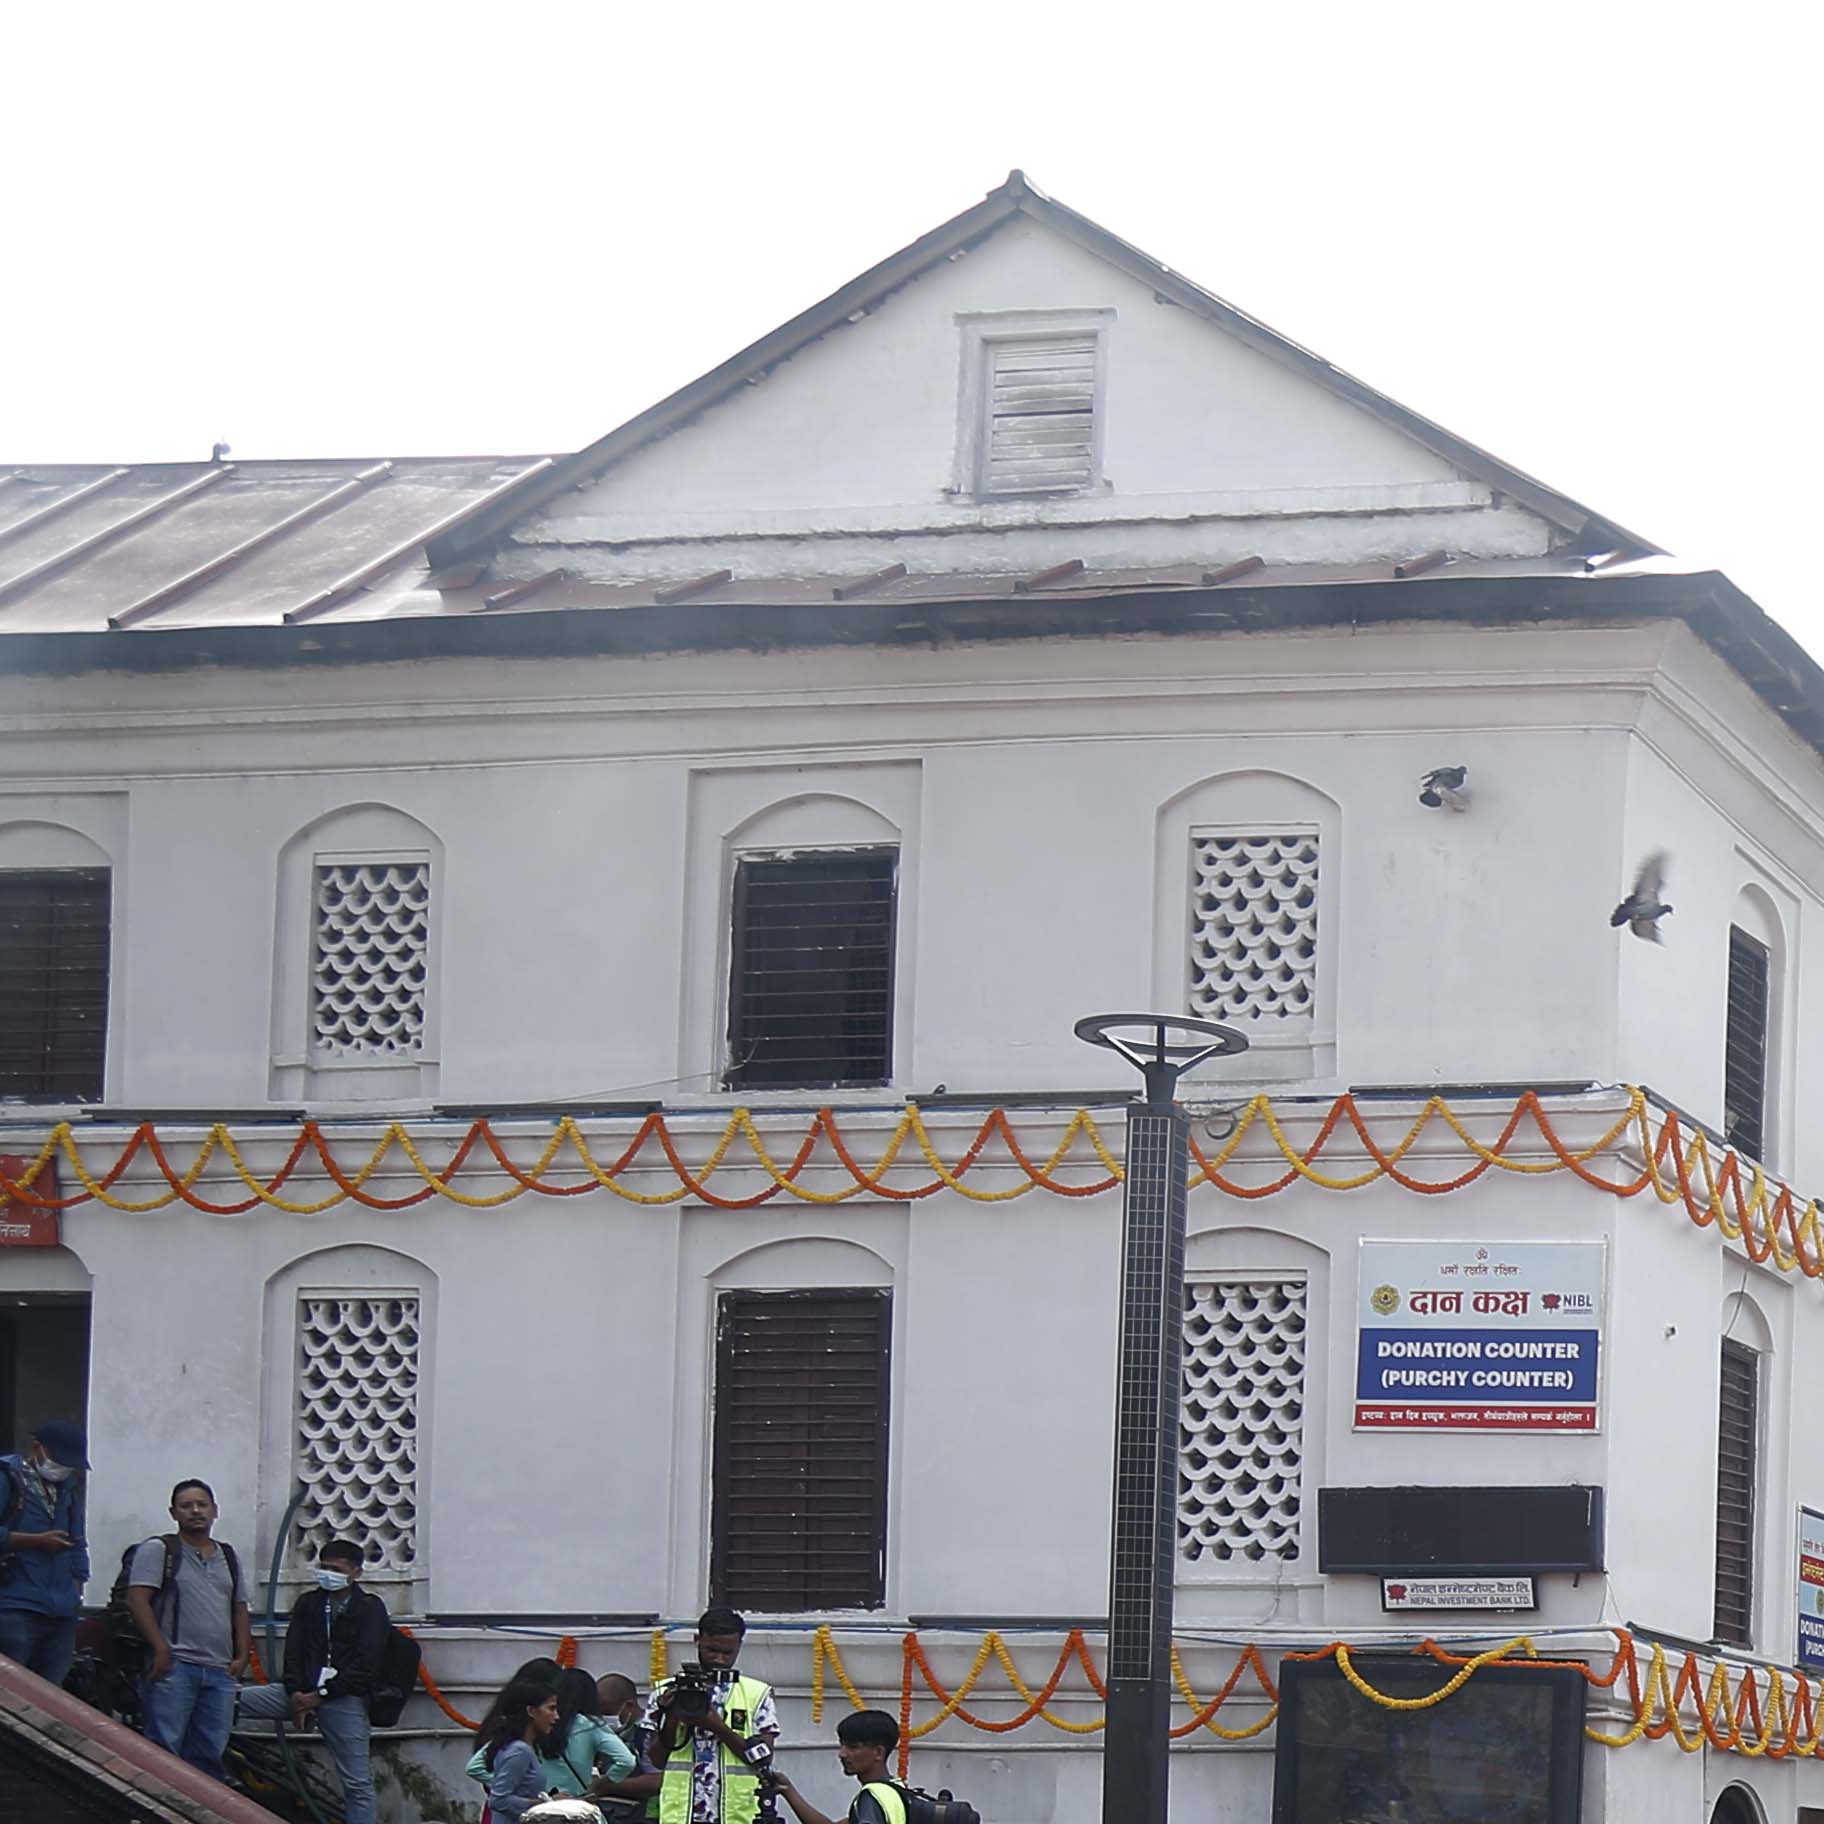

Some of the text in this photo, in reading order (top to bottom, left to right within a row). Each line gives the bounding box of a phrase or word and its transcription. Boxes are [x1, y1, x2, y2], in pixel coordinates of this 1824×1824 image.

[1409, 1291, 1531, 1316] दान कक्ष
[1563, 1294, 1593, 1307] NIBL
[1377, 1341, 1579, 1359] DONATION COUNTER
[1381, 1369, 1574, 1390] (PURCHY COUNTER)
[1410, 1596, 1437, 1605] NEPAL
[1438, 1596, 1489, 1605] INVESTMENT
[1490, 1596, 1514, 1605] BANK
